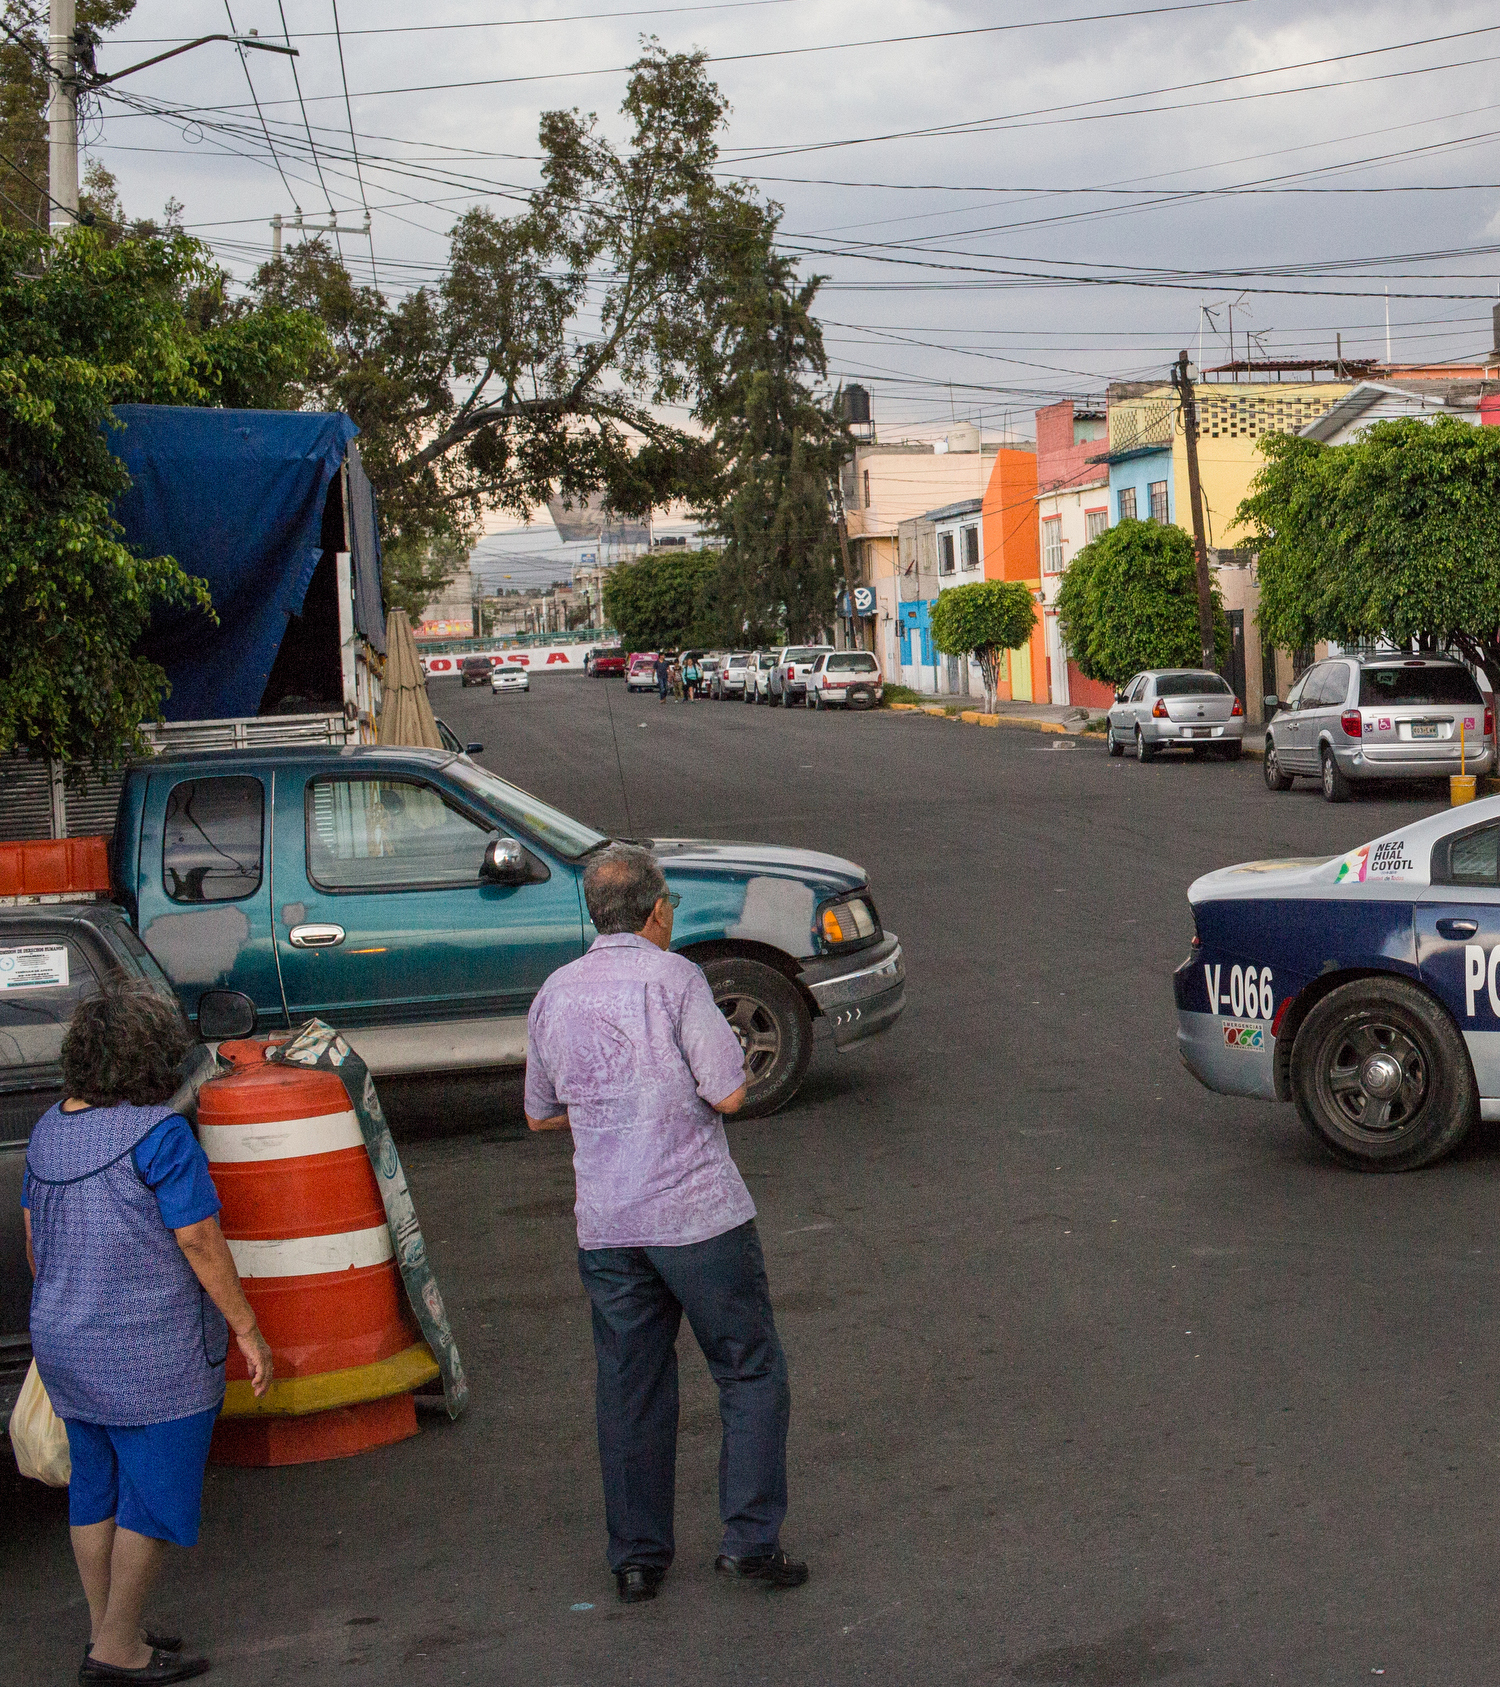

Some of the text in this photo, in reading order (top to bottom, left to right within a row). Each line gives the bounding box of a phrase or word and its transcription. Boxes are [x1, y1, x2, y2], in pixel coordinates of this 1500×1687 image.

[1377, 841, 1404, 852] NEZA
[1374, 850, 1403, 861] HUAL
[1371, 860, 1414, 872] COYOTL
[1204, 964, 1273, 1020] V-066
[1223, 1021, 1263, 1030] EMERGENCIAS
[1225, 1028, 1264, 1047] 066
